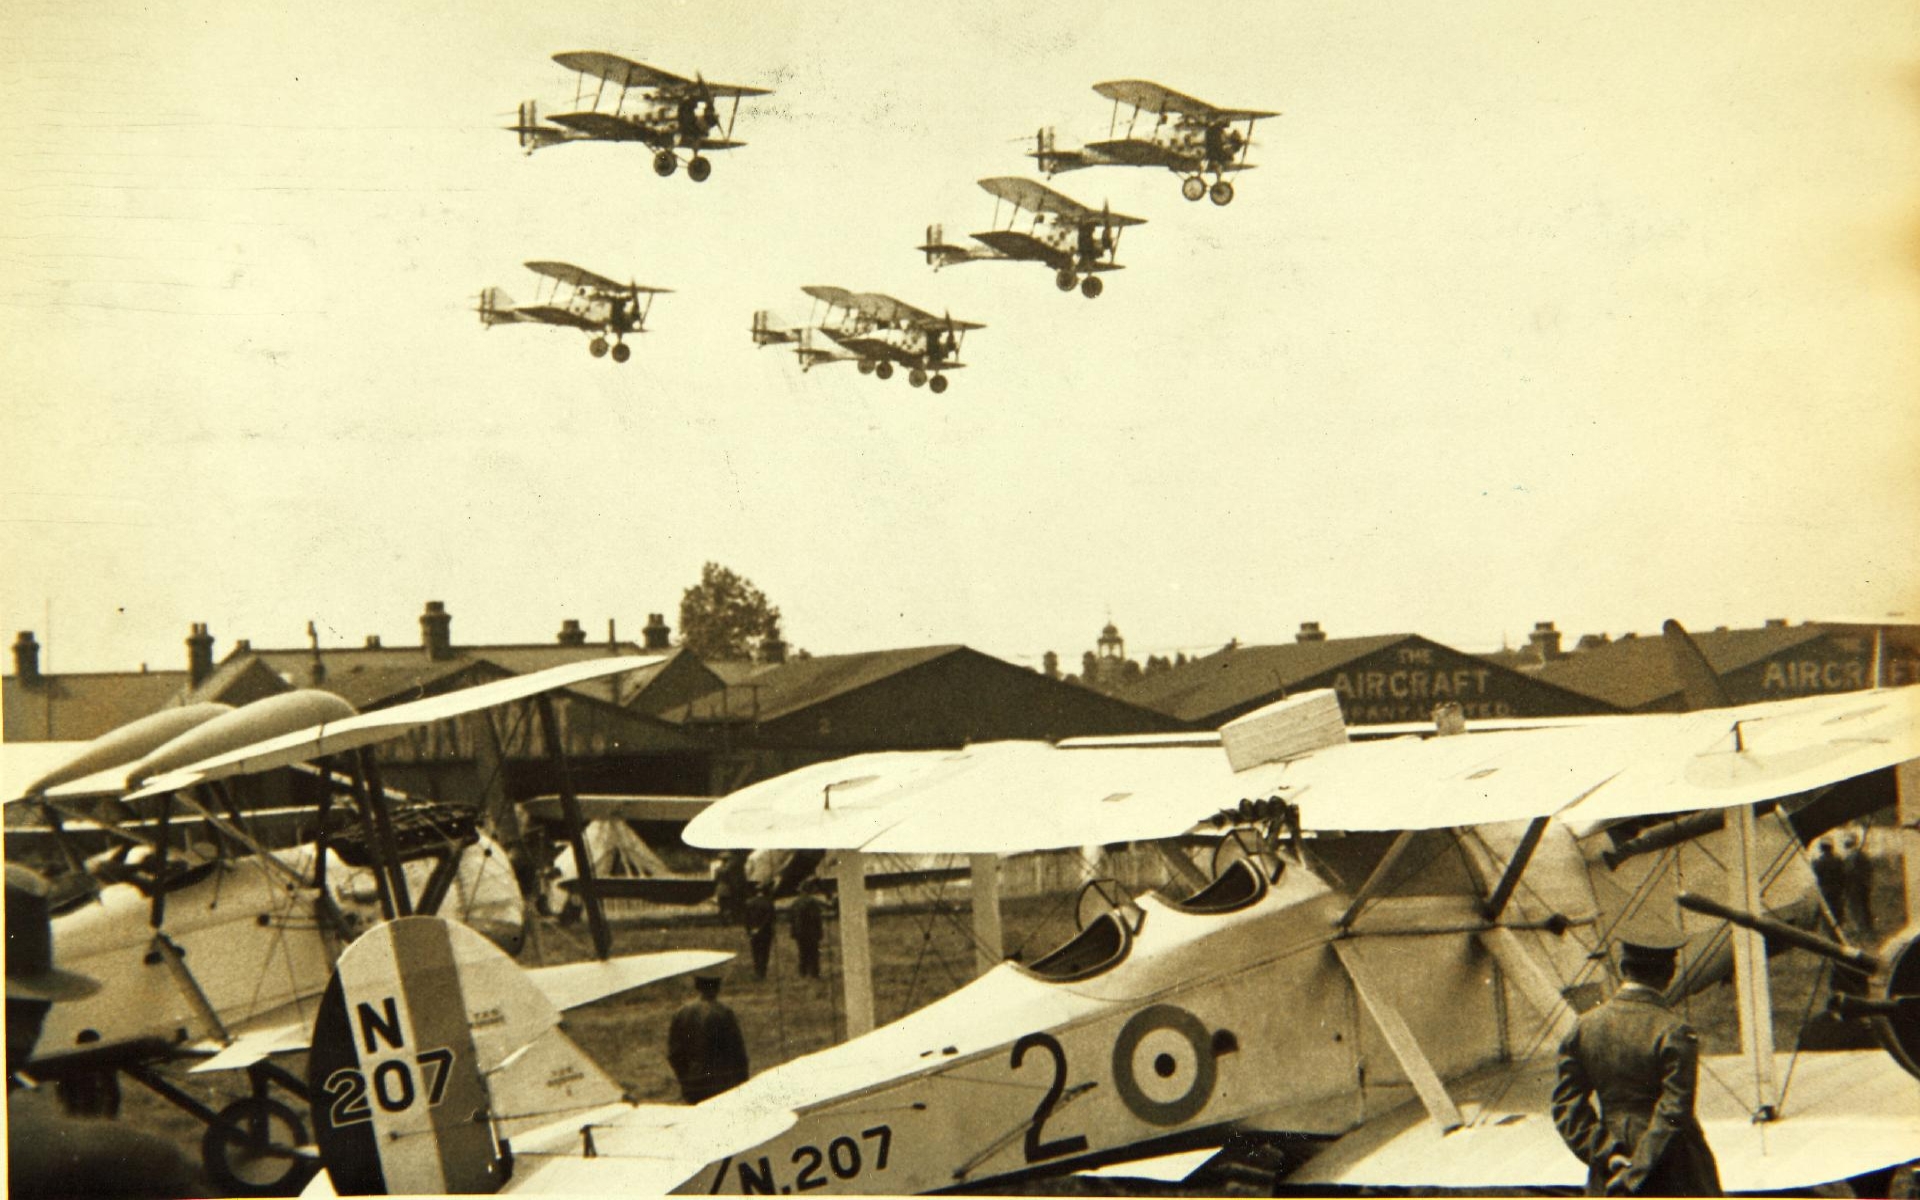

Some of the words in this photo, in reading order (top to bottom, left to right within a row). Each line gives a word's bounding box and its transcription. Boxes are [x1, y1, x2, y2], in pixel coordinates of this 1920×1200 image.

[1333, 669, 1491, 699] AIRCRAFT
[1761, 660, 1920, 689] AIRCRFT
[357, 996, 404, 1054] N
[323, 1046, 455, 1128] 207
[1010, 1031, 1089, 1165] 2
